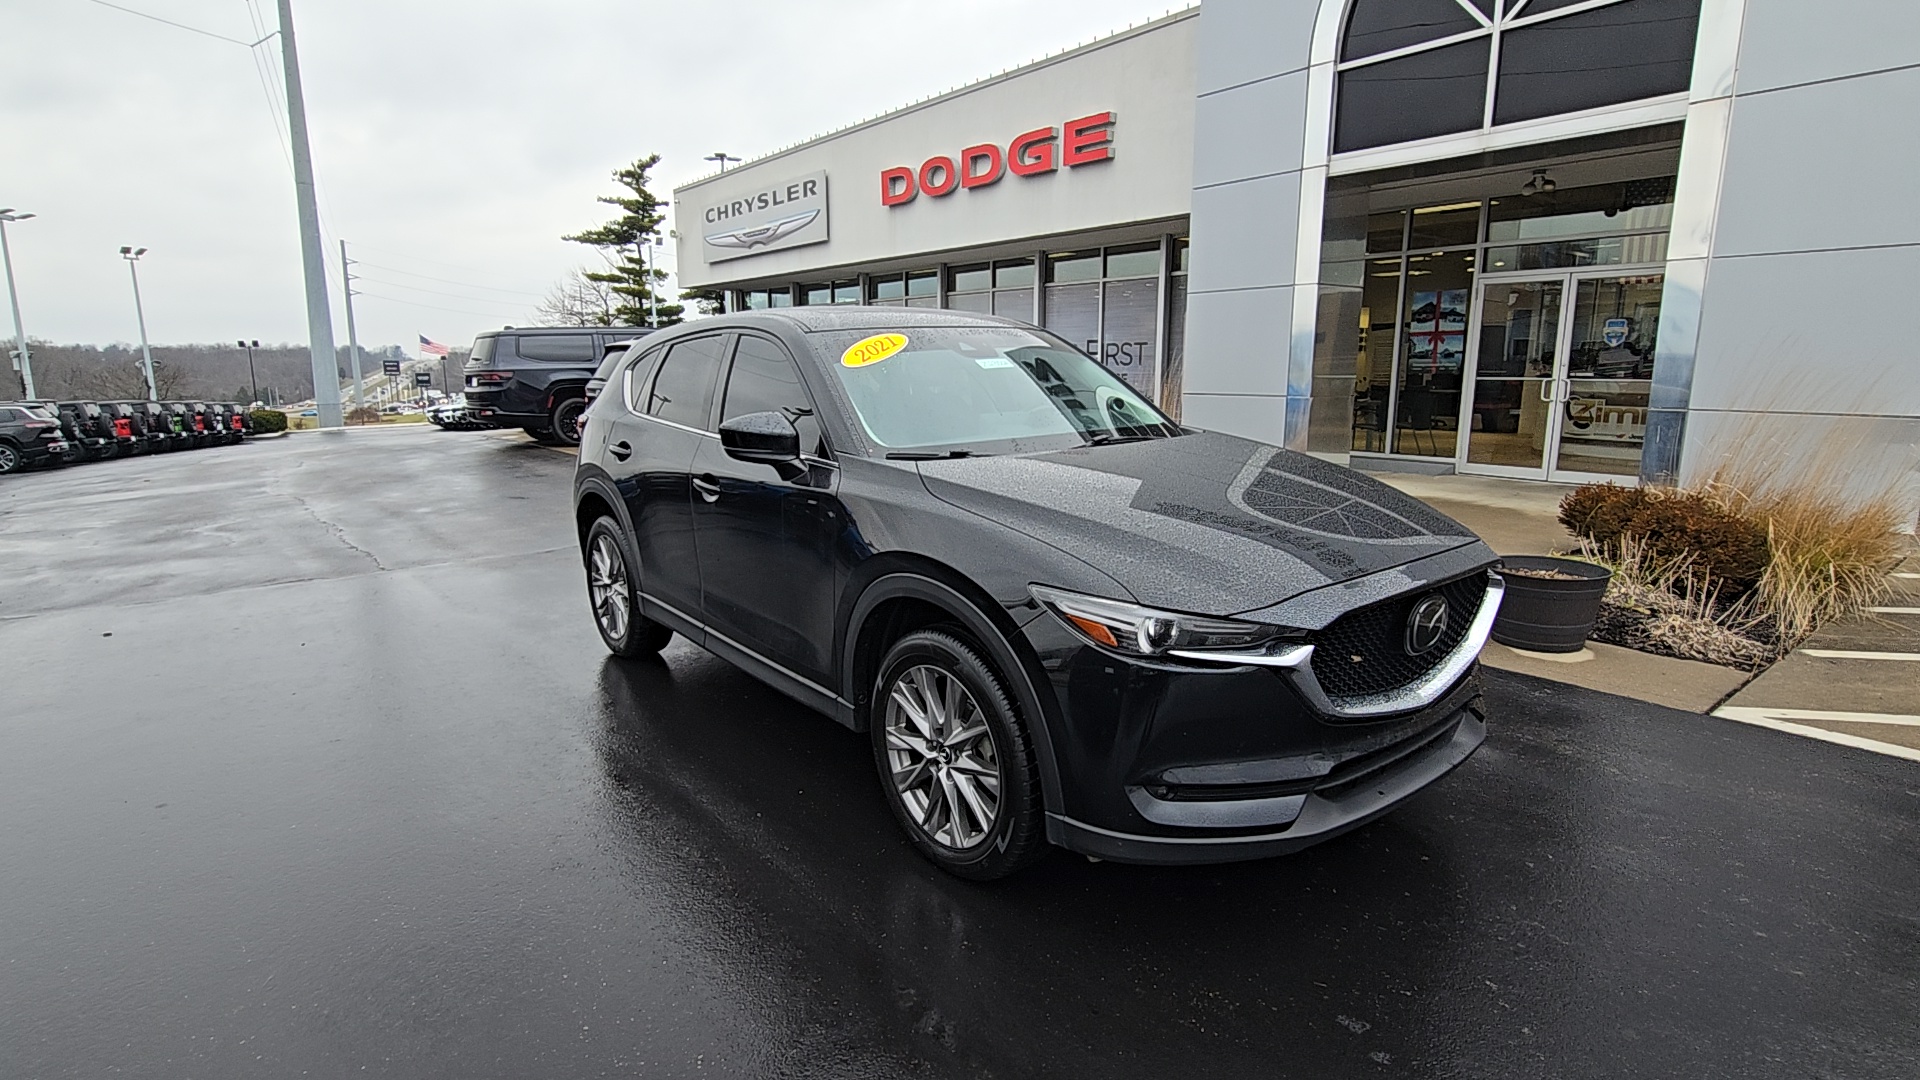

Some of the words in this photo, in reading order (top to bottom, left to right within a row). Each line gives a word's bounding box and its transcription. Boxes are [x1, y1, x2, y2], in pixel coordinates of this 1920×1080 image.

[881, 111, 1117, 206] DODGE
[705, 179, 817, 223] CHRYSLER
[854, 336, 899, 362] 2021
